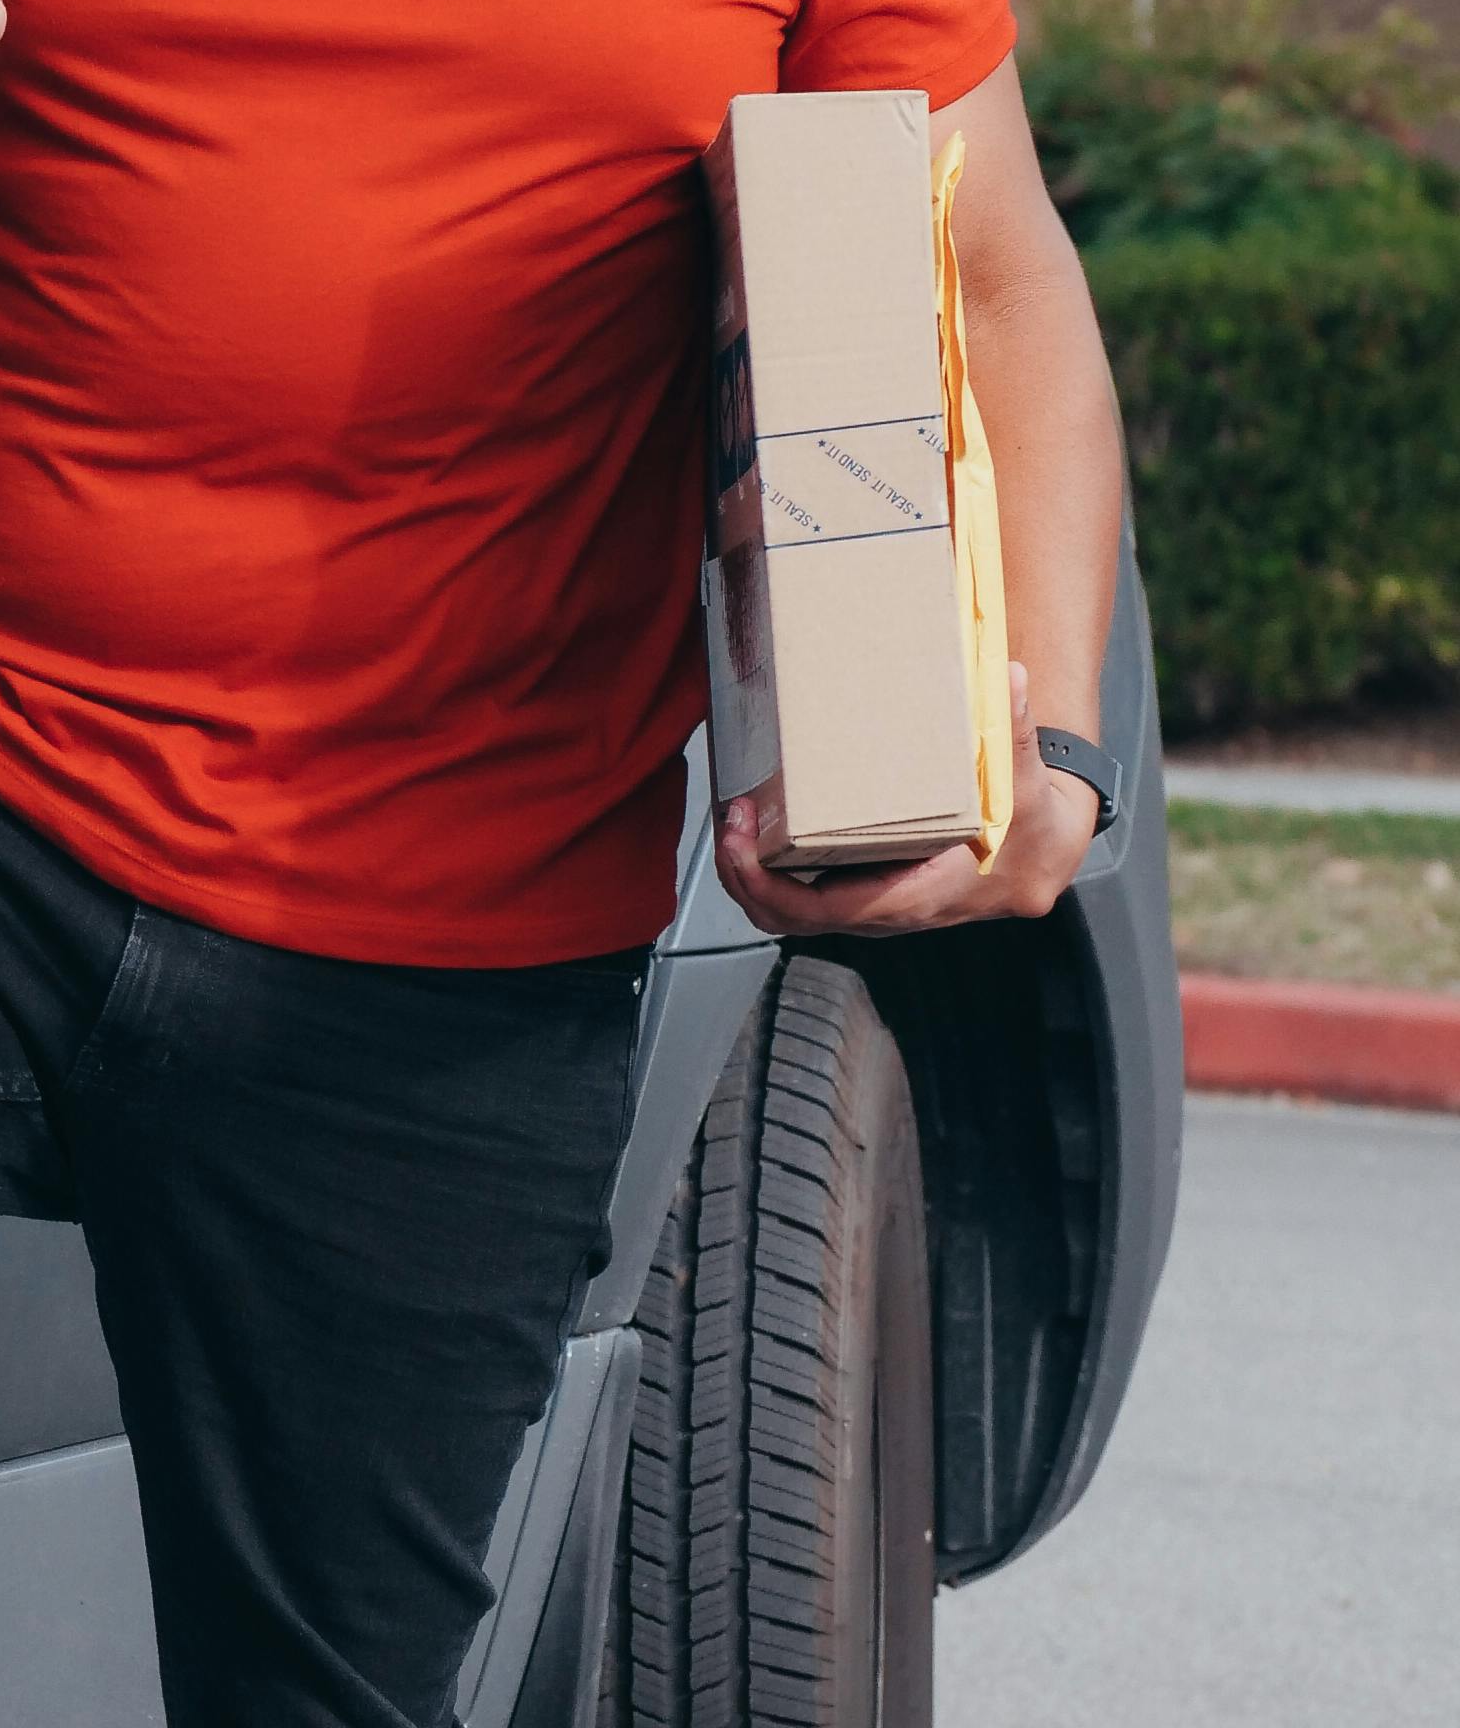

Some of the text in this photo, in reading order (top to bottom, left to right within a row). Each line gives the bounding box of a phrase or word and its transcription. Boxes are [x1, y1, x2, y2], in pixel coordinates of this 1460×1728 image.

[838, 454, 872, 482] SEND
[784, 499, 813, 527] SEAL
[885, 487, 914, 515] SEAL
